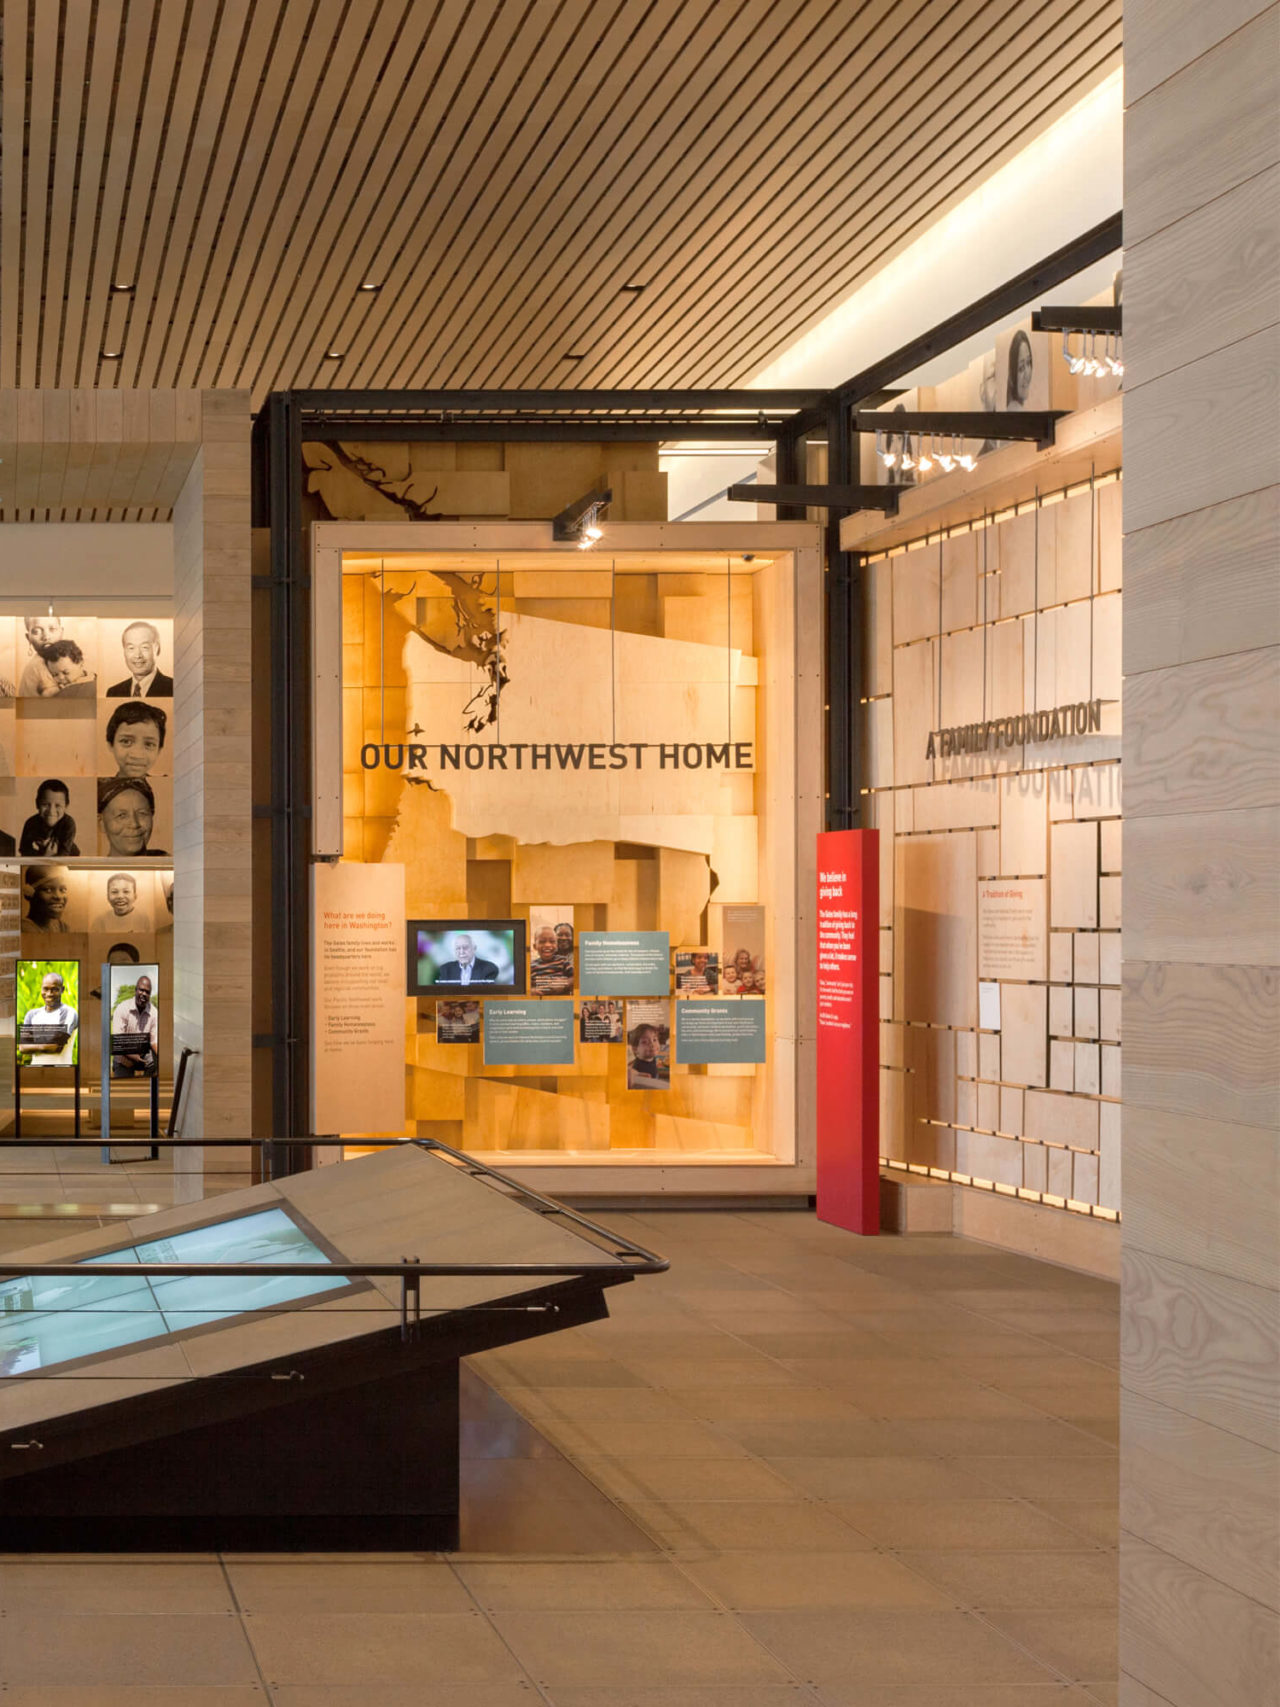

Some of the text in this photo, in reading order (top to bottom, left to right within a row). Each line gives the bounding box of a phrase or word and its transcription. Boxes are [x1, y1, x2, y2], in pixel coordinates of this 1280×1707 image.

[926, 698, 1102, 760] A FAMILY FOUNDATION
[361, 742, 754, 770] OUR NORTHWEST HOME
[819, 872, 826, 882] We
[827, 872, 841, 882] believe
[819, 886, 843, 899] giving back
[367, 912, 385, 921] doing
[349, 922, 392, 931] Washington?
